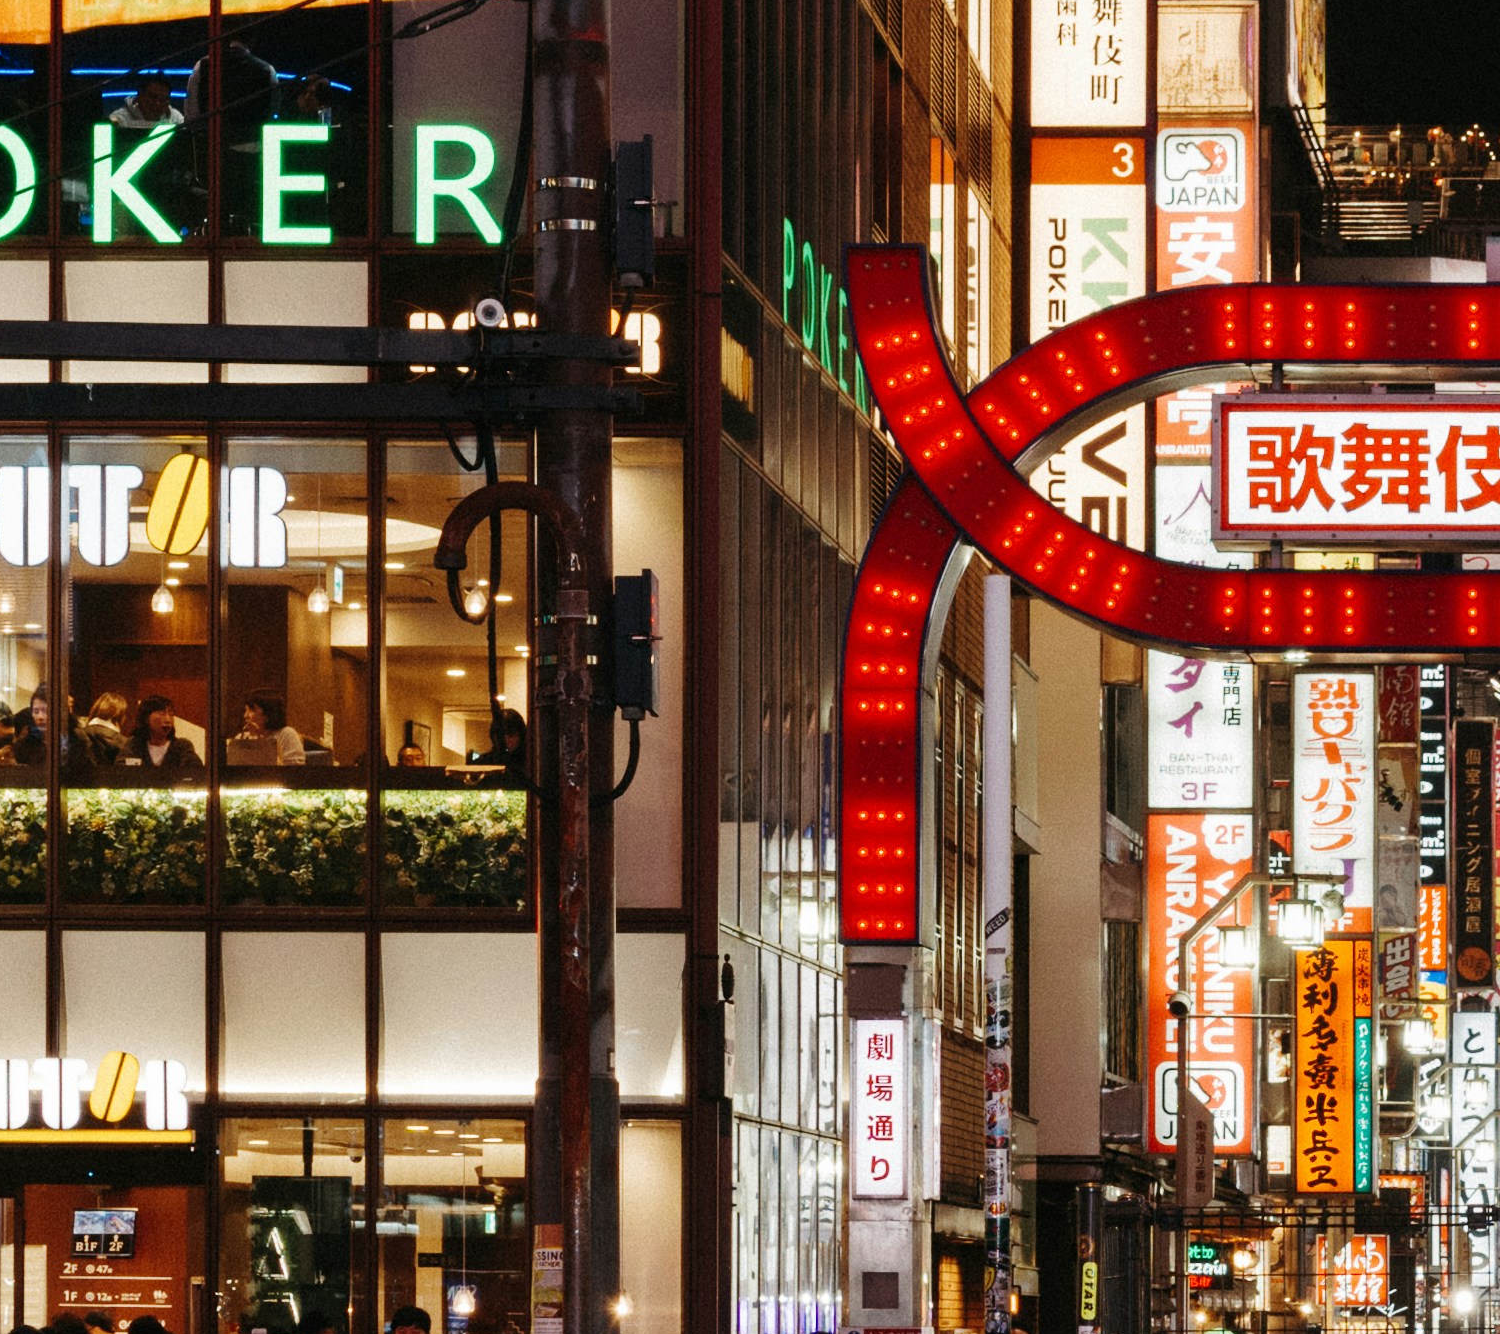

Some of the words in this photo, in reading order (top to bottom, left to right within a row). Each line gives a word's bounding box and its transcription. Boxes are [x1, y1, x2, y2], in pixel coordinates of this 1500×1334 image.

[1112, 143, 1135, 178] 3
[1164, 186, 1239, 206] JAPAN
[1222, 665, 1241, 726] 専門店
[865, 1032, 894, 1182] 劇場通り
[74, 1240, 98, 1253] B1F
